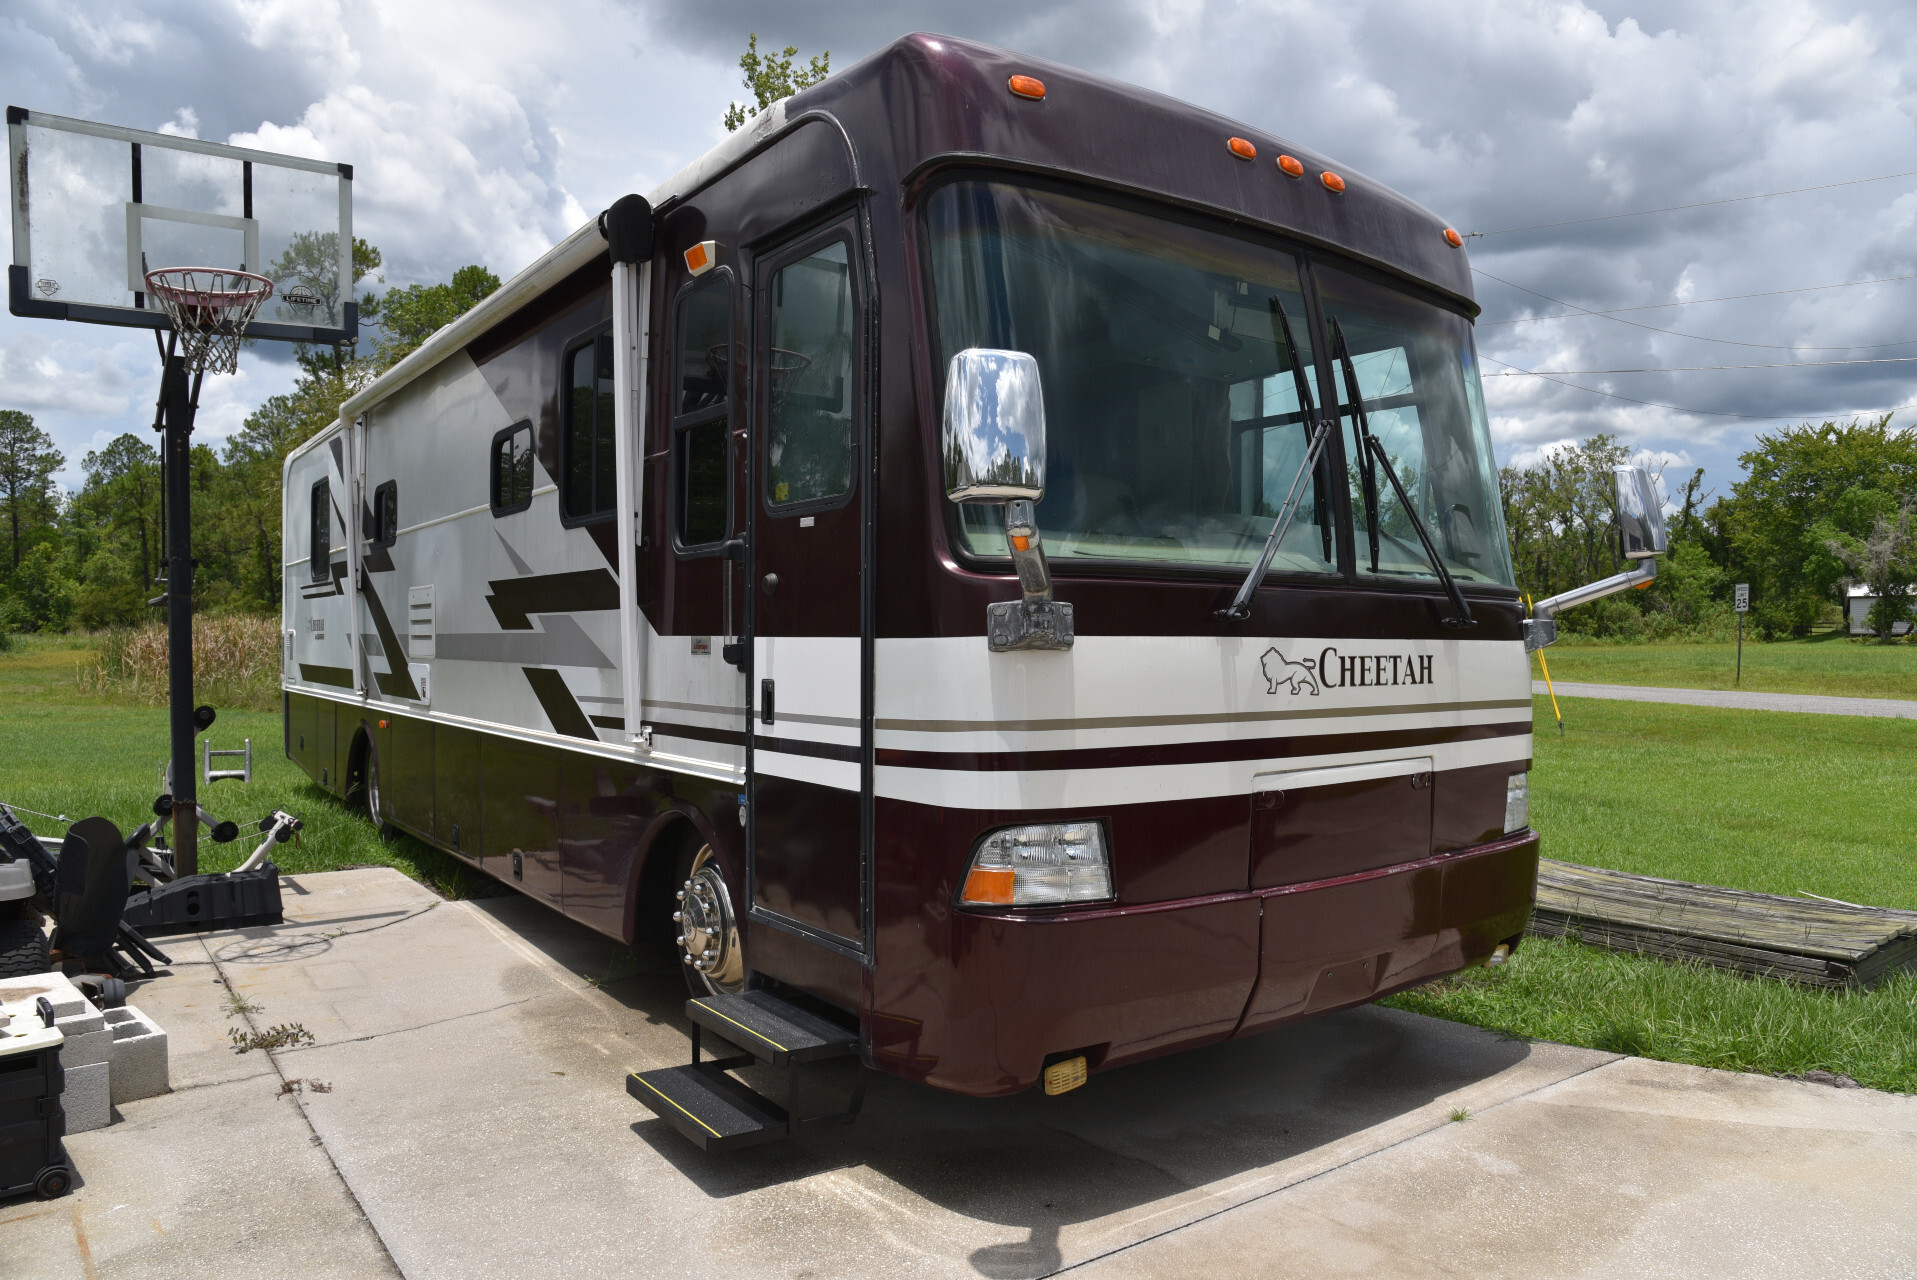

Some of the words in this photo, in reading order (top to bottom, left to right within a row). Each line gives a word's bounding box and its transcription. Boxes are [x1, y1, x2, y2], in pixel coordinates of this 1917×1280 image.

[286, 296, 318, 304] LIFETIME
[1736, 598, 1748, 609] 25
[1319, 647, 1434, 689] CHEETAH
